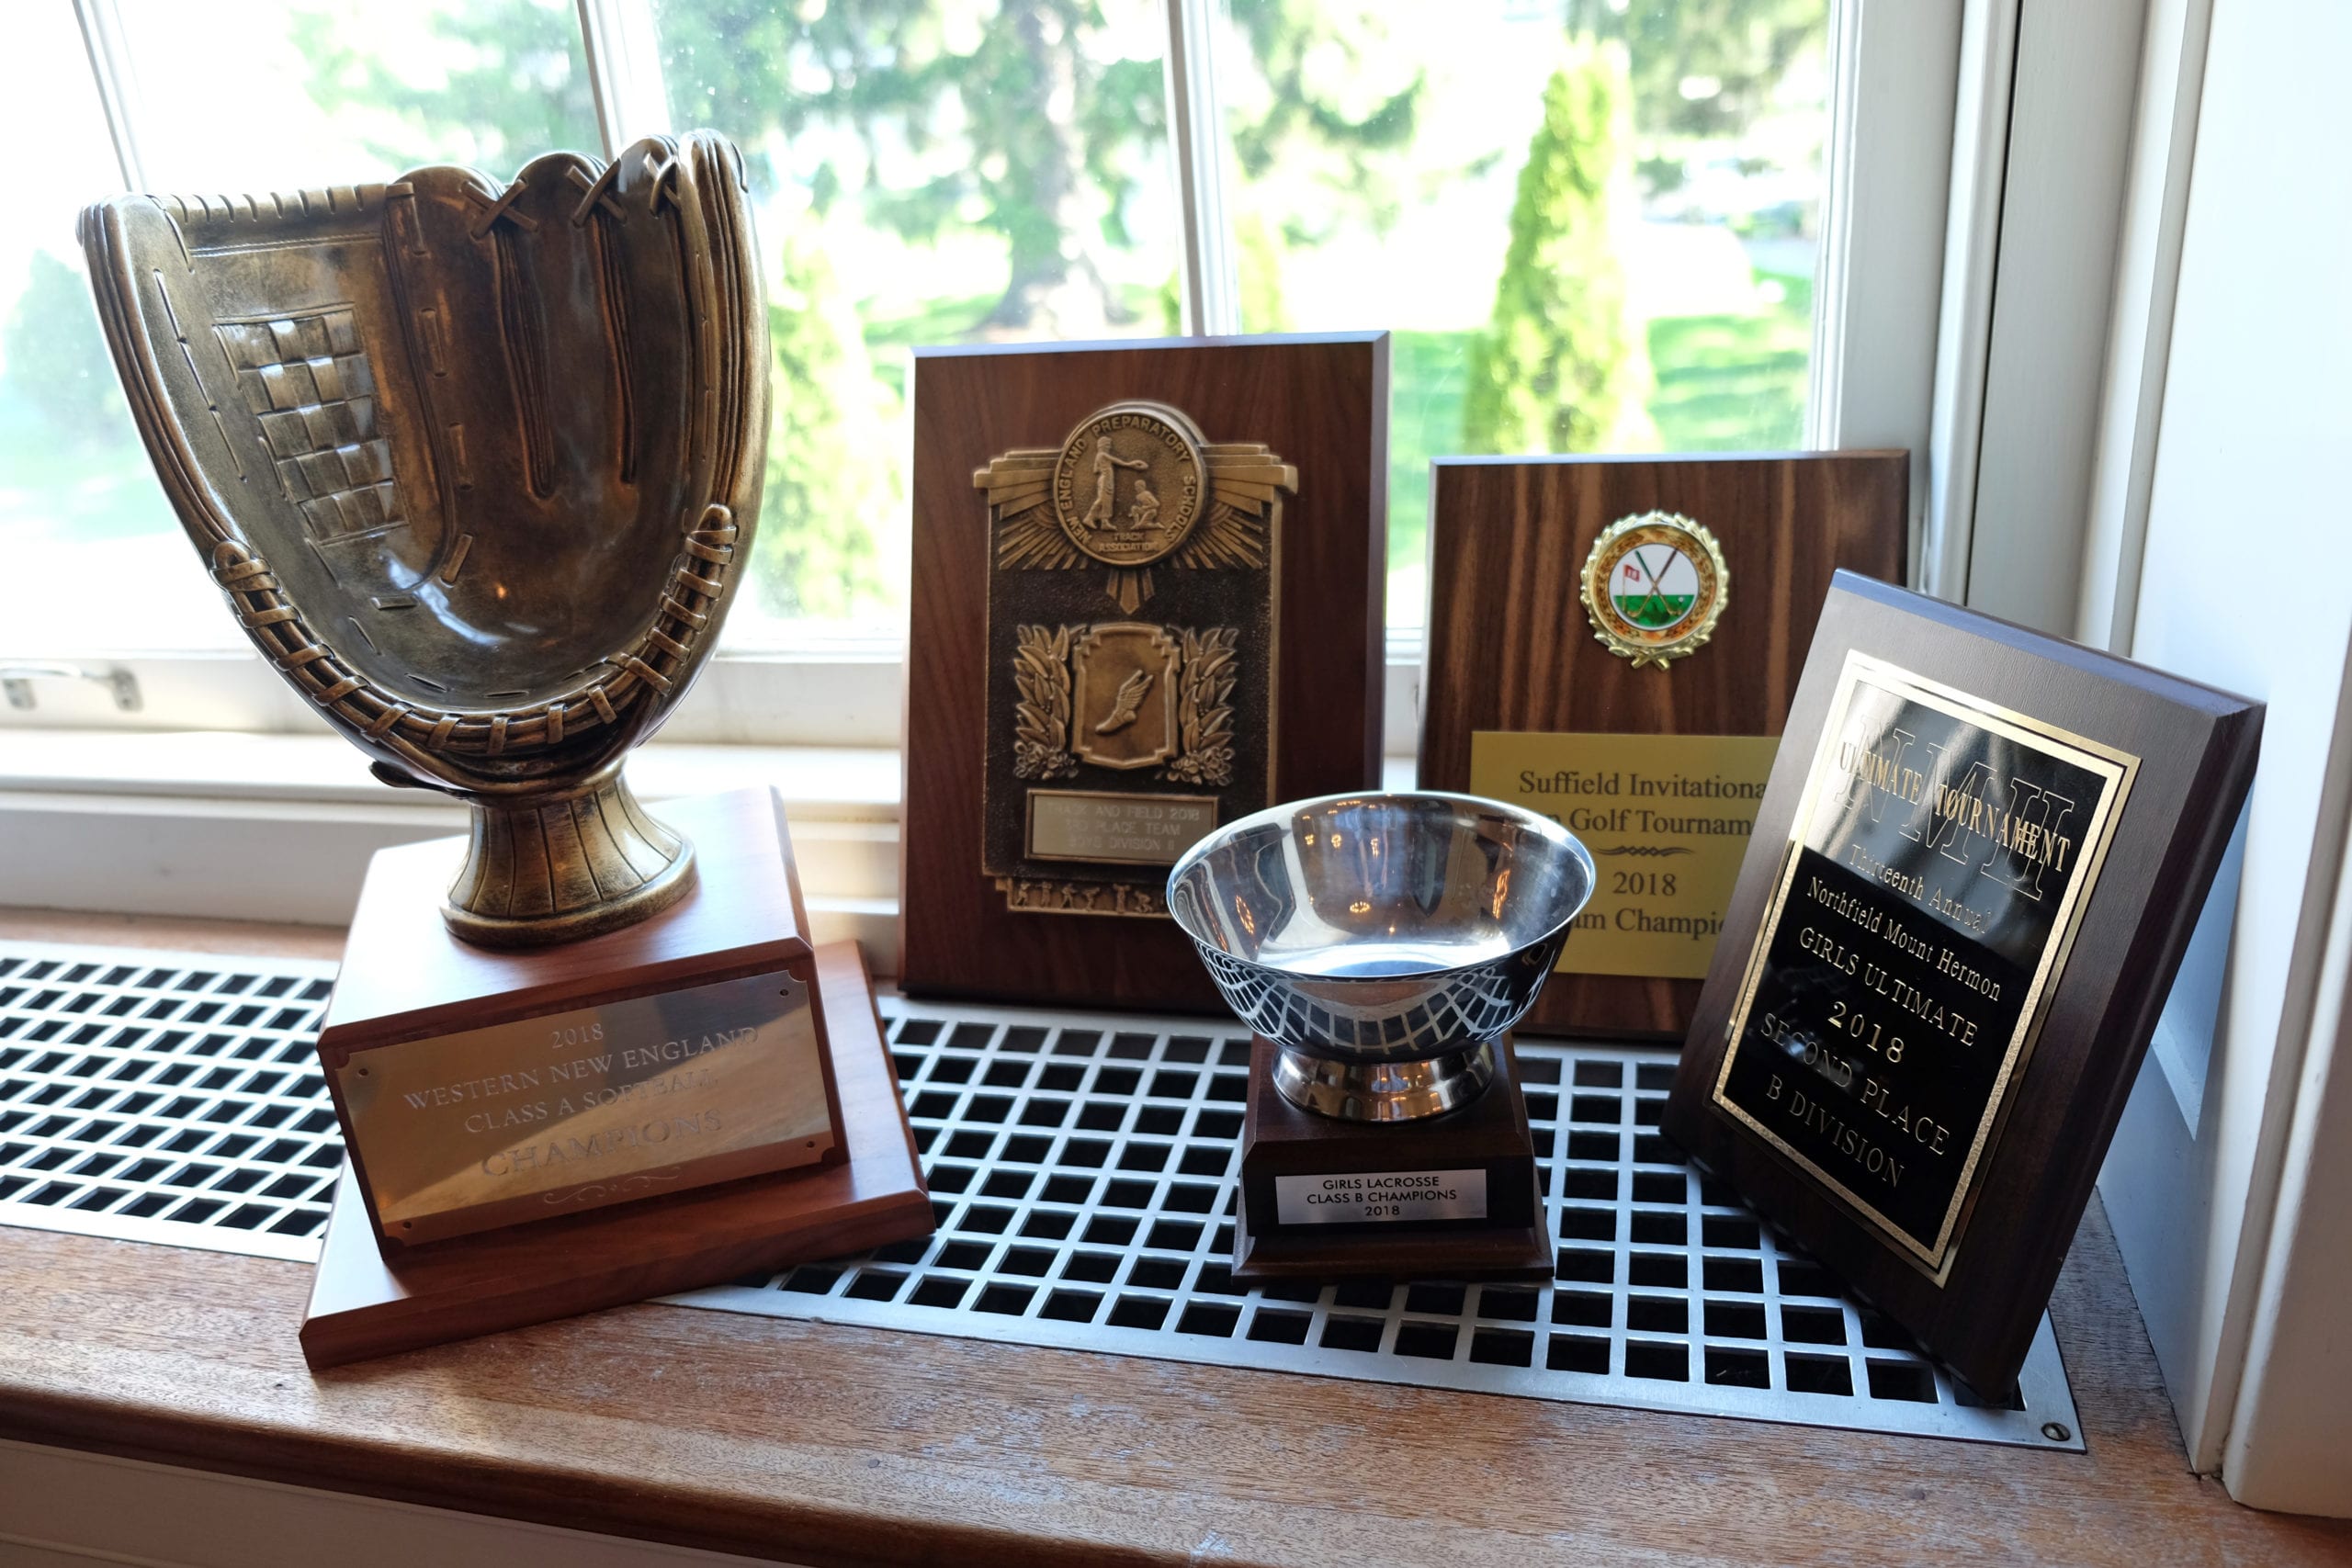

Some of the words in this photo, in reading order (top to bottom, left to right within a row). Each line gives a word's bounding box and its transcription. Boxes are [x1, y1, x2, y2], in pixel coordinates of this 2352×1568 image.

[1091, 415, 1191, 462] PREPARATORY
[1059, 438, 1087, 511] ENGLAND
[1165, 476, 1196, 541] SCHOOLS
[1067, 516, 1092, 544] NEW
[1114, 532, 1145, 541] TRACK
[1519, 771, 1620, 795] Suffield
[1628, 773, 1767, 800] Invitationa
[1095, 821, 1136, 834] PLACE
[1146, 823, 1181, 836] TEAM
[1096, 806, 1120, 818] AND
[1127, 807, 1162, 819] FIELD
[1170, 808, 1200, 821] 2018
[1569, 808, 1634, 832] Golf
[1637, 810, 1752, 836] Tournam
[1935, 784, 2070, 873] TOURNAMENT
[1110, 838, 1160, 852] DIVISION
[1612, 872, 1676, 897] 2018
[1849, 844, 1925, 901] Thirteenth
[1928, 887, 1992, 934] Annual
[1615, 908, 1724, 941] Champi
[1806, 876, 1882, 933] Northfield
[1883, 919, 1933, 964] Mount
[1936, 948, 2002, 1002] Hermon
[1799, 927, 1860, 976] GIRLS
[1864, 963, 1979, 1048] ULTIMATE
[551, 1022, 604, 1048] 2018
[1827, 1000, 1905, 1064] 2018
[403, 1068, 541, 1111] WESTERN
[550, 1054, 614, 1084] NEW
[624, 1026, 759, 1068] ENGLAND
[1760, 1012, 1853, 1088] SECOND
[1860, 1077, 1951, 1156] PLACE
[464, 1102, 548, 1134] CLASS
[558, 1097, 578, 1116] A
[582, 1067, 718, 1111] SOFTBALL
[481, 1109, 722, 1178] CHAMPIONS
[1766, 1074, 1783, 1100] B
[1789, 1090, 1905, 1188] DIVISION
[1306, 1192, 1351, 1204] CLASS
[1355, 1191, 1363, 1202] B
[1368, 1190, 1457, 1203] CHAMPIONS
[1322, 1179, 1362, 1190] GIRLS
[1367, 1177, 1440, 1189] LACROSSE
[1364, 1205, 1400, 1216] 2018
